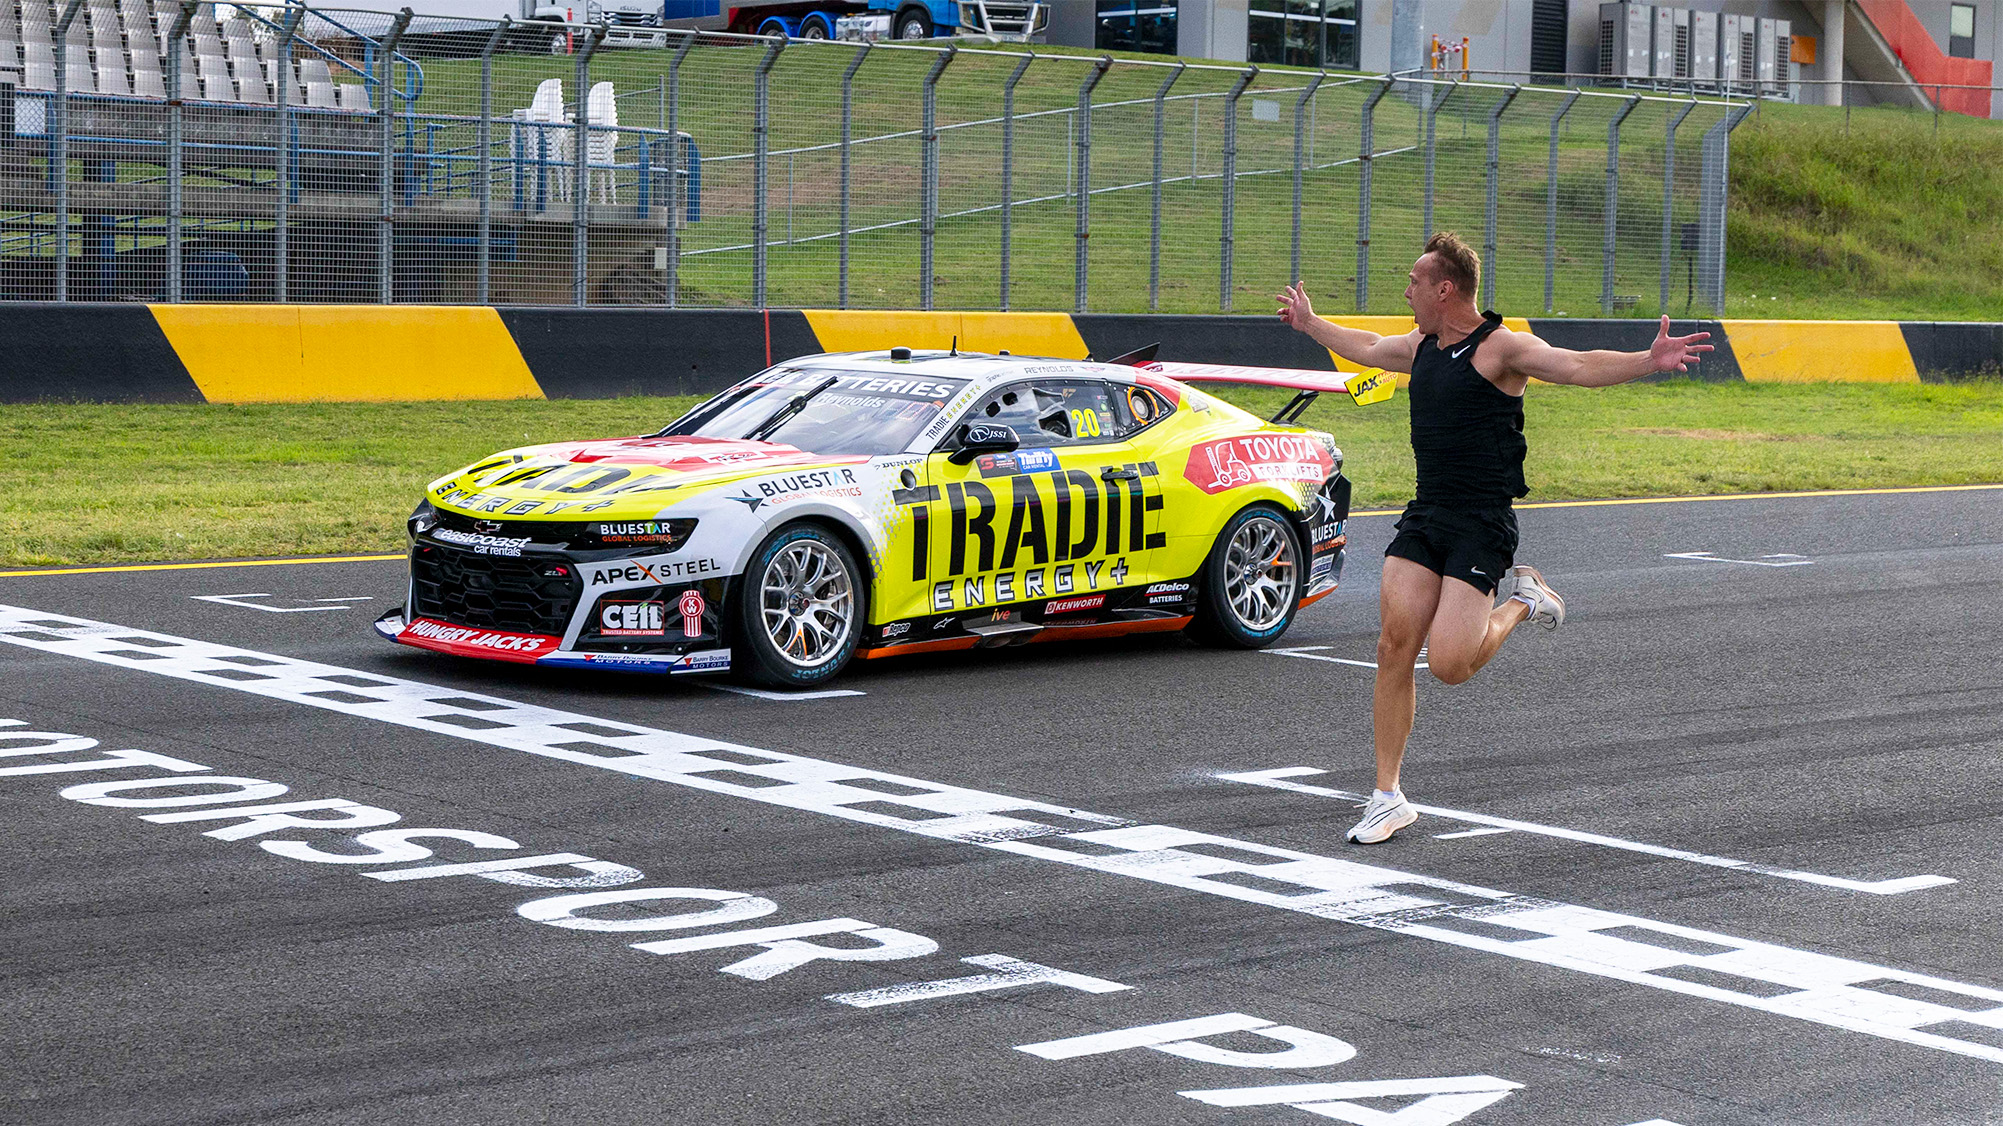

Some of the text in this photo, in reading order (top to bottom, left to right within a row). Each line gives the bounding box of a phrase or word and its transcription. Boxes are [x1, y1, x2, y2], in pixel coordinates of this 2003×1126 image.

[1024, 365, 1075, 375] REYNOLDS
[1354, 375, 1379, 397] JAX
[926, 415, 950, 440] TRADIE
[1072, 408, 1101, 438] 20
[1239, 436, 1320, 461] TOYOTA
[881, 458, 923, 469] DUNLOP
[758, 468, 857, 498] BLUESTAR
[600, 522, 671, 535] BLUESTAR
[892, 462, 1167, 583] TRADIE
[440, 529, 532, 548] eastcoast
[633, 534, 672, 542] LOGISTICS
[474, 545, 521, 557] car rentals
[591, 558, 721, 586] APEX STEEL
[1146, 583, 1190, 594] ACDelco
[688, 599, 695, 607] K
[1055, 597, 1104, 611] KENWORTH
[1149, 595, 1183, 603] BATTERIES
[687, 606, 698, 614] W
[991, 607, 1011, 621] ive
[408, 620, 546, 652] HUNGRY JACK'S
[1013, 1012, 1687, 1126] PA
